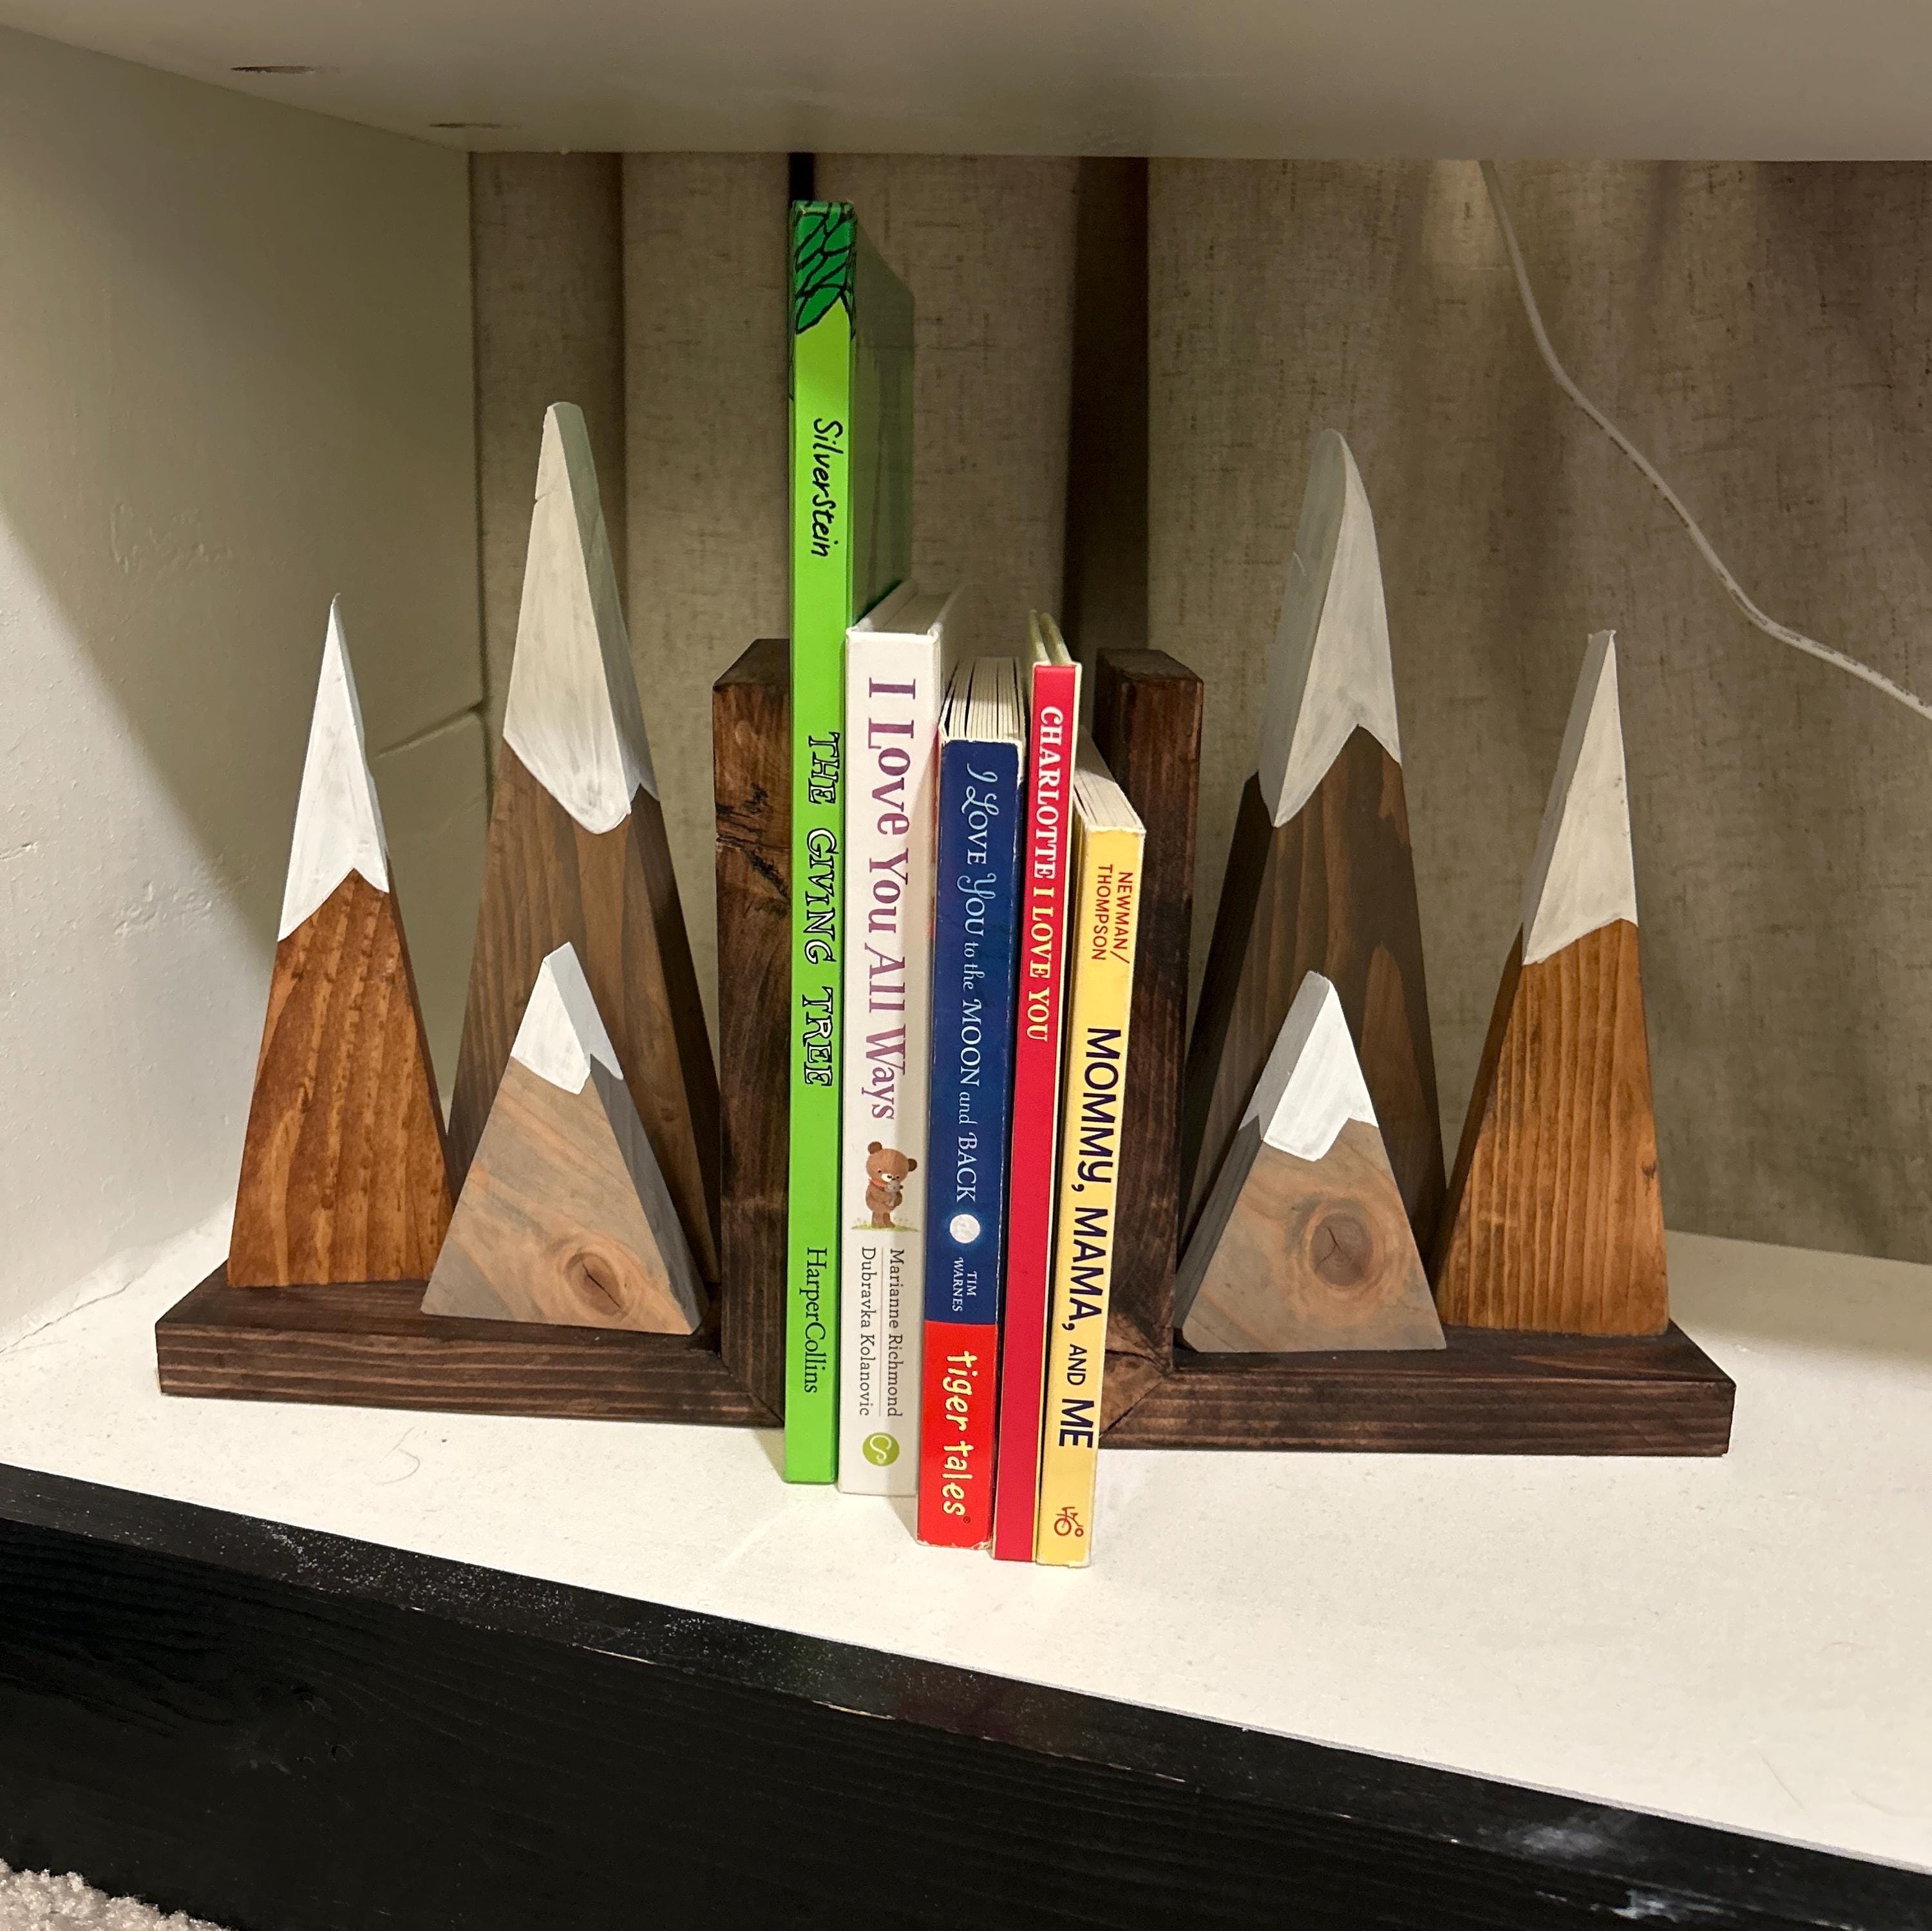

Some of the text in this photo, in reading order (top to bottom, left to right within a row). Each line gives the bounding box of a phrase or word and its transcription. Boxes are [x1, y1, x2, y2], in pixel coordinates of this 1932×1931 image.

[811, 417, 844, 558] Silverstein
[967, 763, 998, 784] I
[802, 731, 840, 1087] THE GIVING TREE
[861, 677, 916, 1120] I Love You All Ways
[1026, 706, 1063, 1042] CHARLOTTE I LOVE YOU
[1091, 864, 1113, 961] THOMPSON
[1110, 871, 1134, 965] NEWMAN/
[962, 963, 985, 990] the
[963, 941, 980, 958] to
[958, 998, 983, 1088] MOON
[958, 1091, 978, 1125] and
[956, 1131, 978, 1203] BACK
[951, 1257, 964, 1313] WARNES
[966, 1270, 978, 1297] TIM
[1061, 1207, 1108, 1332] MAMA,
[799, 1247, 828, 1394] HarperCollins
[859, 1247, 876, 1417] Dubravka Kolanovic
[887, 1248, 905, 1417] Marianne Richmond
[1066, 1343, 1088, 1386] AND
[941, 1350, 978, 1432] tiger
[1057, 1397, 1095, 1449] ME
